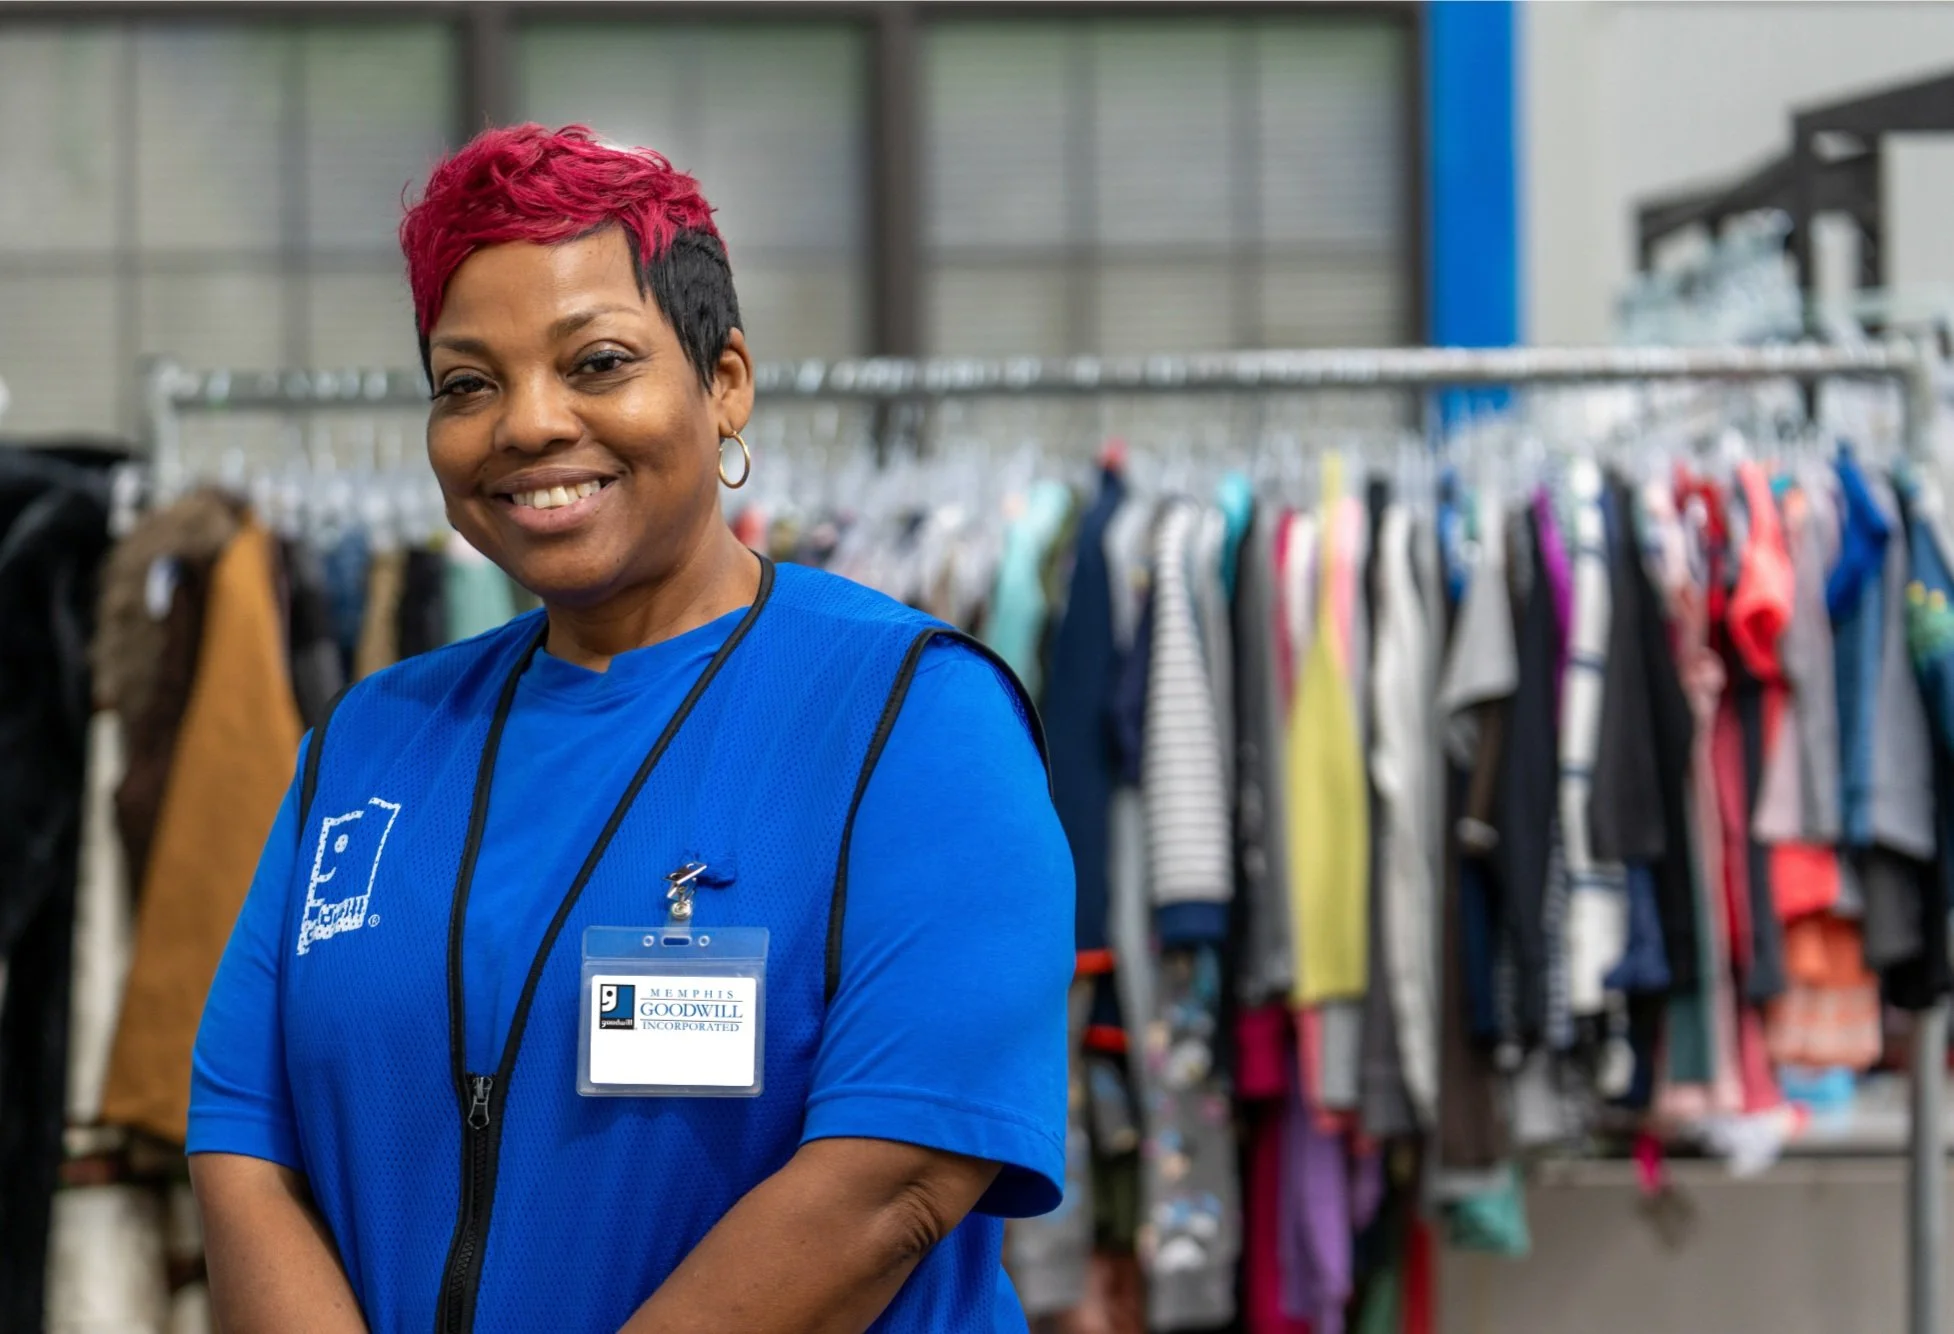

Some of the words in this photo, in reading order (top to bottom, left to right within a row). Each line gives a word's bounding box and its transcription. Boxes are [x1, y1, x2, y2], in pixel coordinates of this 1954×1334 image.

[650, 988, 734, 999] MEMPHIS
[640, 1002, 743, 1018] GOODWILL
[601, 1018, 633, 1027] goodwill
[643, 1021, 739, 1032] INCORPORATED
